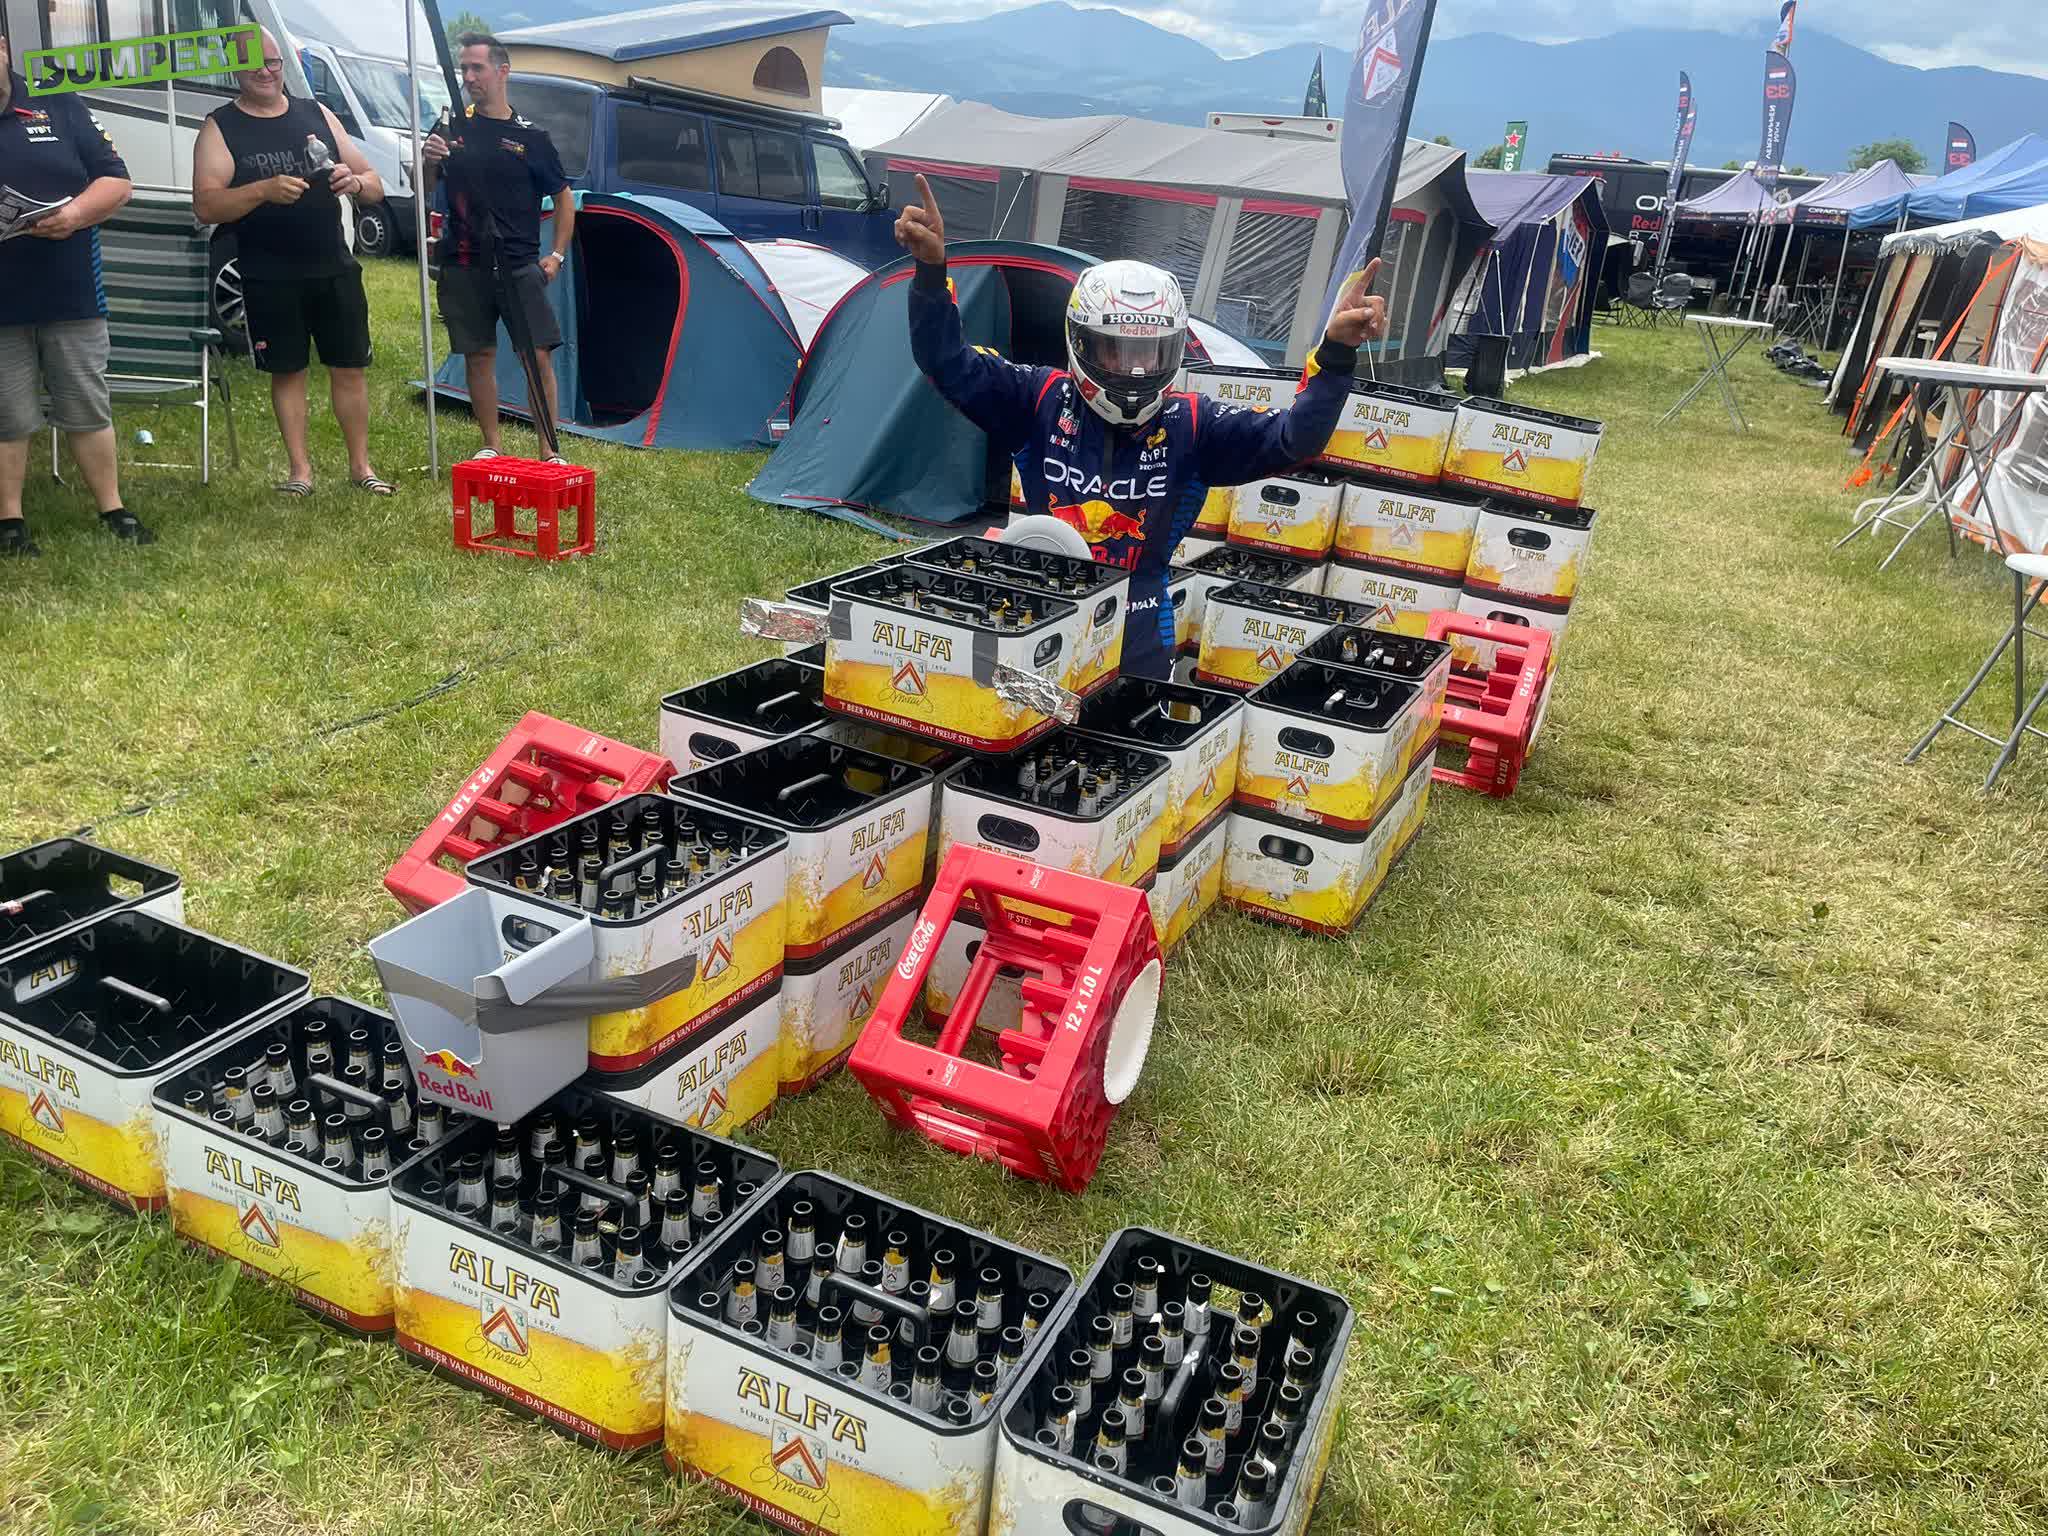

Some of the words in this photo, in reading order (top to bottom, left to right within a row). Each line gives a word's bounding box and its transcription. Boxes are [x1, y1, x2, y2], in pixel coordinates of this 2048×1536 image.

[1109, 313, 1169, 326] HONDA
[1120, 325, 1138, 335] Red
[1140, 326, 1158, 336] Bull
[1218, 383, 1271, 401] ALFA
[1353, 403, 1410, 427] ALFA
[1492, 423, 1552, 450] ALFA
[1044, 457, 1168, 500] ORACLE
[1258, 503, 1297, 520] ALFA
[1378, 499, 1435, 523] ALFA
[1361, 578, 1418, 603] ALFA
[1131, 598, 1158, 613] MAX
[872, 619, 953, 661] ALFA
[1243, 616, 1307, 646] ALFA
[846, 703, 864, 715] BEER
[864, 708, 880, 719] VAN
[919, 724, 934, 734] DAT
[935, 729, 956, 739] PREUF
[958, 735, 974, 745] STE!
[479, 767, 495, 783] 12
[1275, 750, 1330, 778] ALFA
[850, 808, 906, 856] ALFA
[1016, 914, 1032, 926] STE!
[30, 957, 80, 990] AL
[838, 937, 892, 991] ALFA
[1088, 966, 1103, 975] L
[1079, 975, 1098, 999] 1.0
[659, 1033, 676, 1049] BEER
[676, 1023, 691, 1039] VAN
[728, 993, 742, 1007] DAT
[741, 981, 760, 998] PREUF
[759, 970, 774, 985] STE!
[1075, 1000, 1088, 1014] x
[1065, 1012, 1083, 1032] 12
[0, 1037, 81, 1099] ALFA
[678, 1030, 747, 1101] ALFA
[418, 1071, 456, 1099] Red
[456, 1083, 493, 1111] Bull
[204, 1146, 303, 1212] ALFA
[449, 1243, 560, 1319] ALFA
[452, 1281, 480, 1298] SINDS
[329, 1306, 349, 1321] STE!
[425, 1346, 448, 1366] BEER
[450, 1357, 470, 1375] VAN
[525, 1394, 546, 1412] DAT
[547, 1404, 579, 1427] PREUF
[579, 1421, 602, 1438] STE!
[737, 1365, 869, 1453] ALFA
[739, 1406, 771, 1426] SINDS
[834, 1449, 860, 1467] 1870
[729, 1486, 753, 1507] VAN
